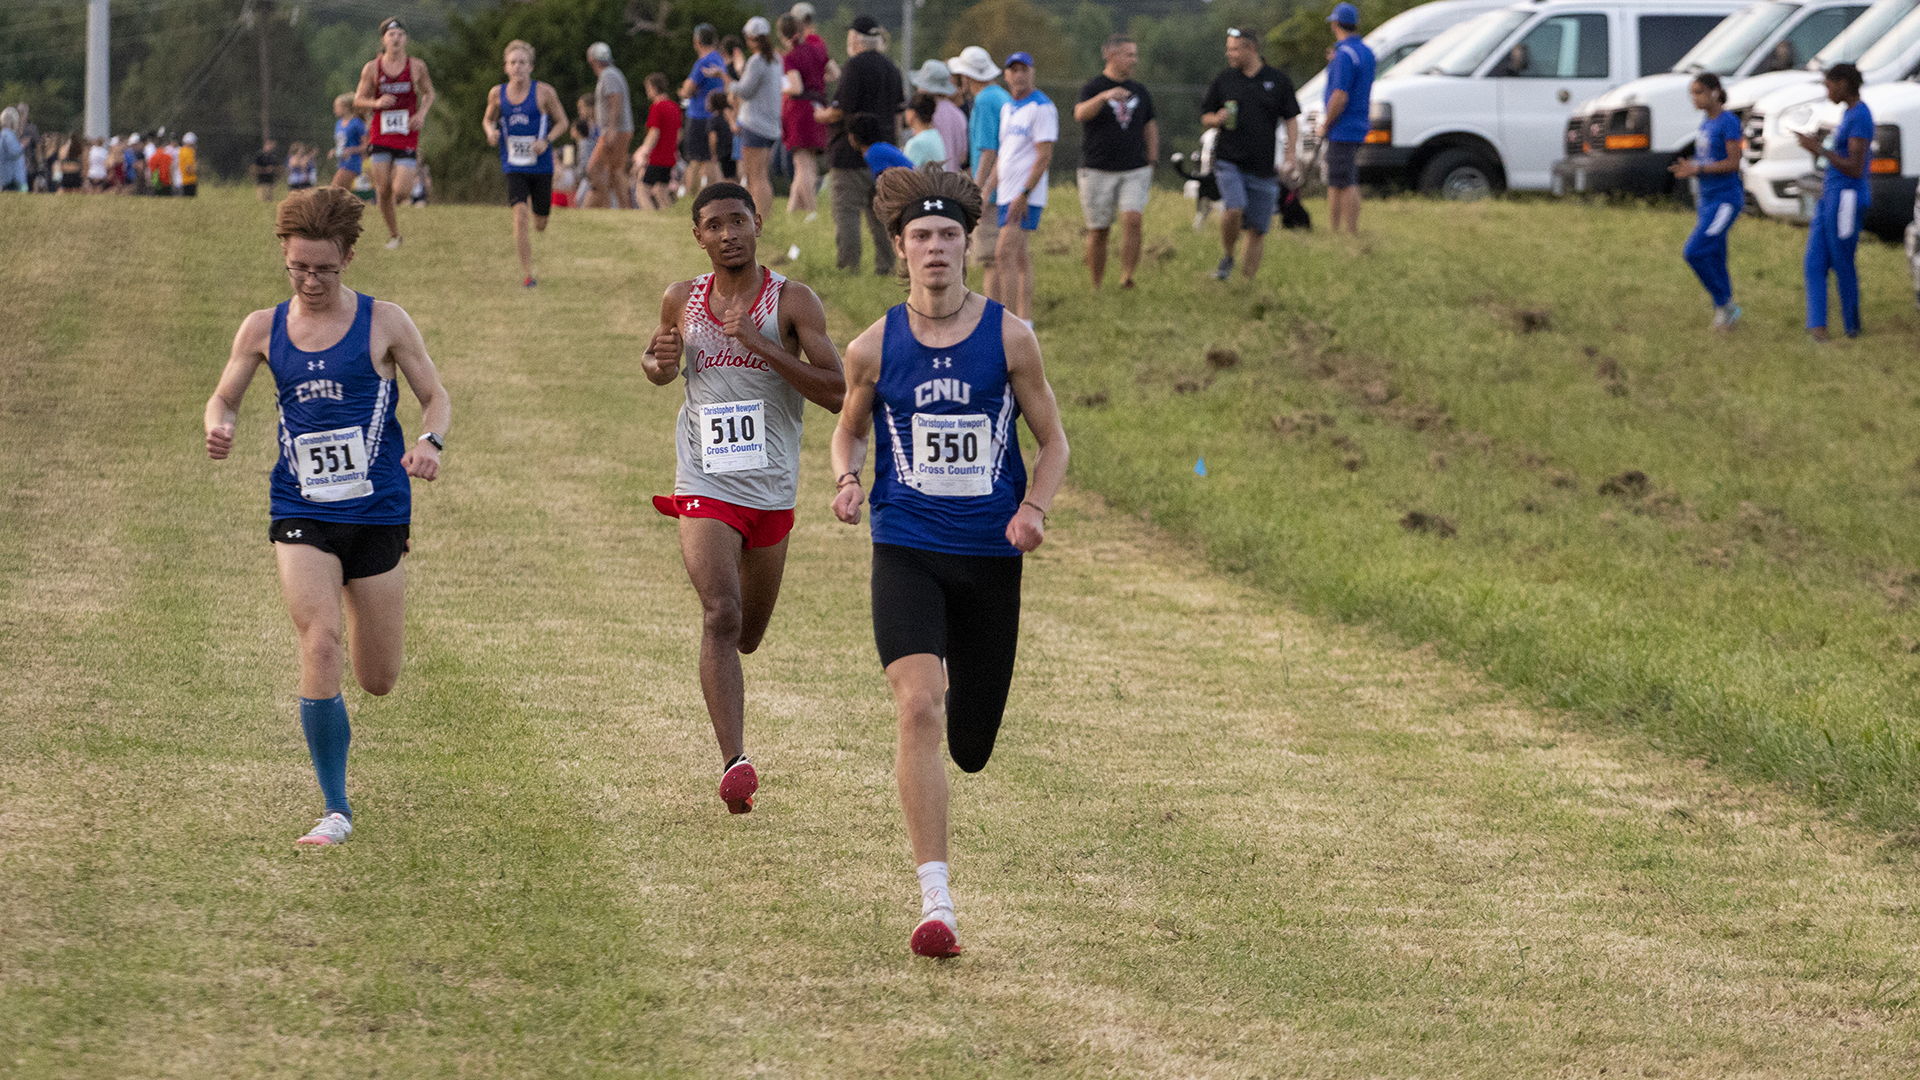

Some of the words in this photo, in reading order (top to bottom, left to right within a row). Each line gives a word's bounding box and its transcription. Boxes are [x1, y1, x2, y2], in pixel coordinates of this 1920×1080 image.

[695, 347, 770, 373] Catholic
[295, 379, 344, 403] CNU
[913, 378, 972, 408] CNU
[703, 405, 735, 417] Christopher
[735, 402, 761, 414] Newport
[711, 415, 755, 445] 510
[917, 416, 956, 430] Christopher
[957, 418, 986, 429] Newport
[309, 443, 356, 475] 551
[706, 446, 729, 455] Cross
[730, 442, 763, 453] Country
[926, 432, 978, 463] 550
[305, 475, 330, 486] Cross
[331, 470, 365, 483] Country
[919, 462, 945, 475] Cross
[947, 464, 986, 476] Country
